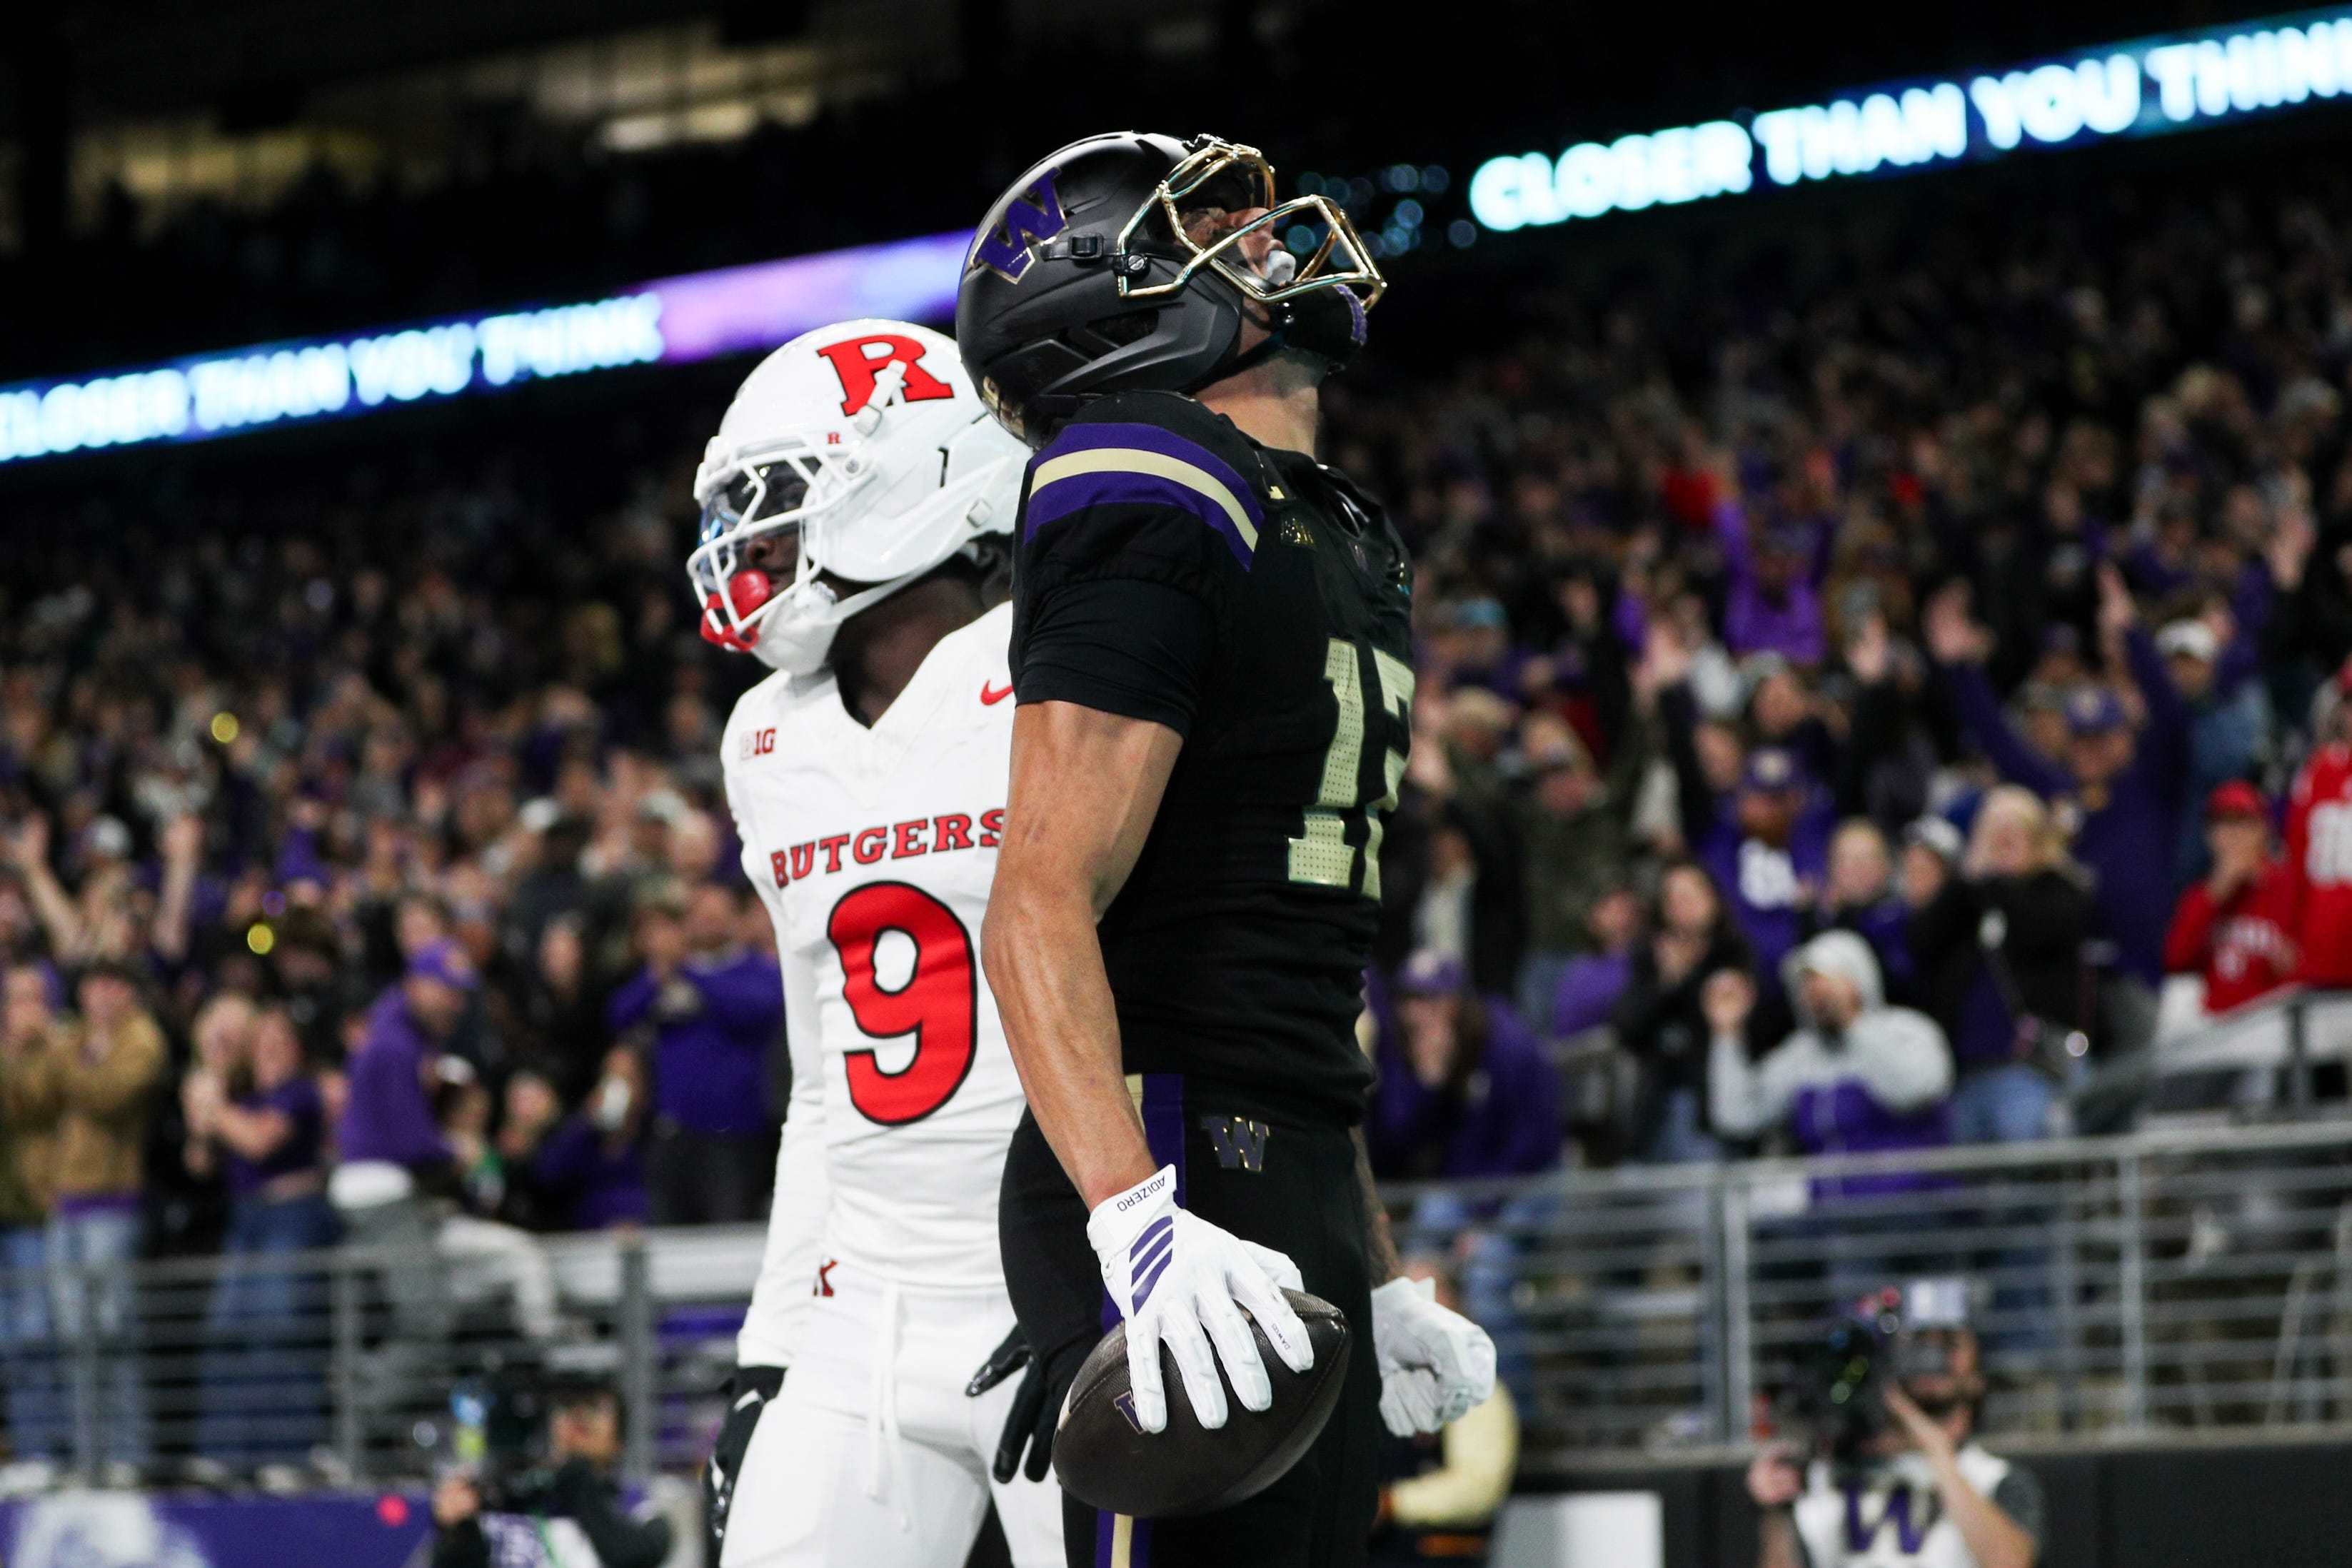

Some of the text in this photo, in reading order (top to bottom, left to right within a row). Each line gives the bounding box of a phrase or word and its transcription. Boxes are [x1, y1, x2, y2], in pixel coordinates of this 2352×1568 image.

[1471, 120, 1752, 231] CLOSER
[1752, 82, 1966, 185] THAN
[1971, 52, 2140, 150] YOU
[970, 166, 1069, 284] W
[817, 334, 955, 417] R
[828, 433, 841, 444] R
[770, 808, 1005, 889] RUTGERS
[826, 880, 978, 1126] 9
[1200, 1117, 1270, 1172] W
[1117, 1175, 1165, 1212] ADIZERO
